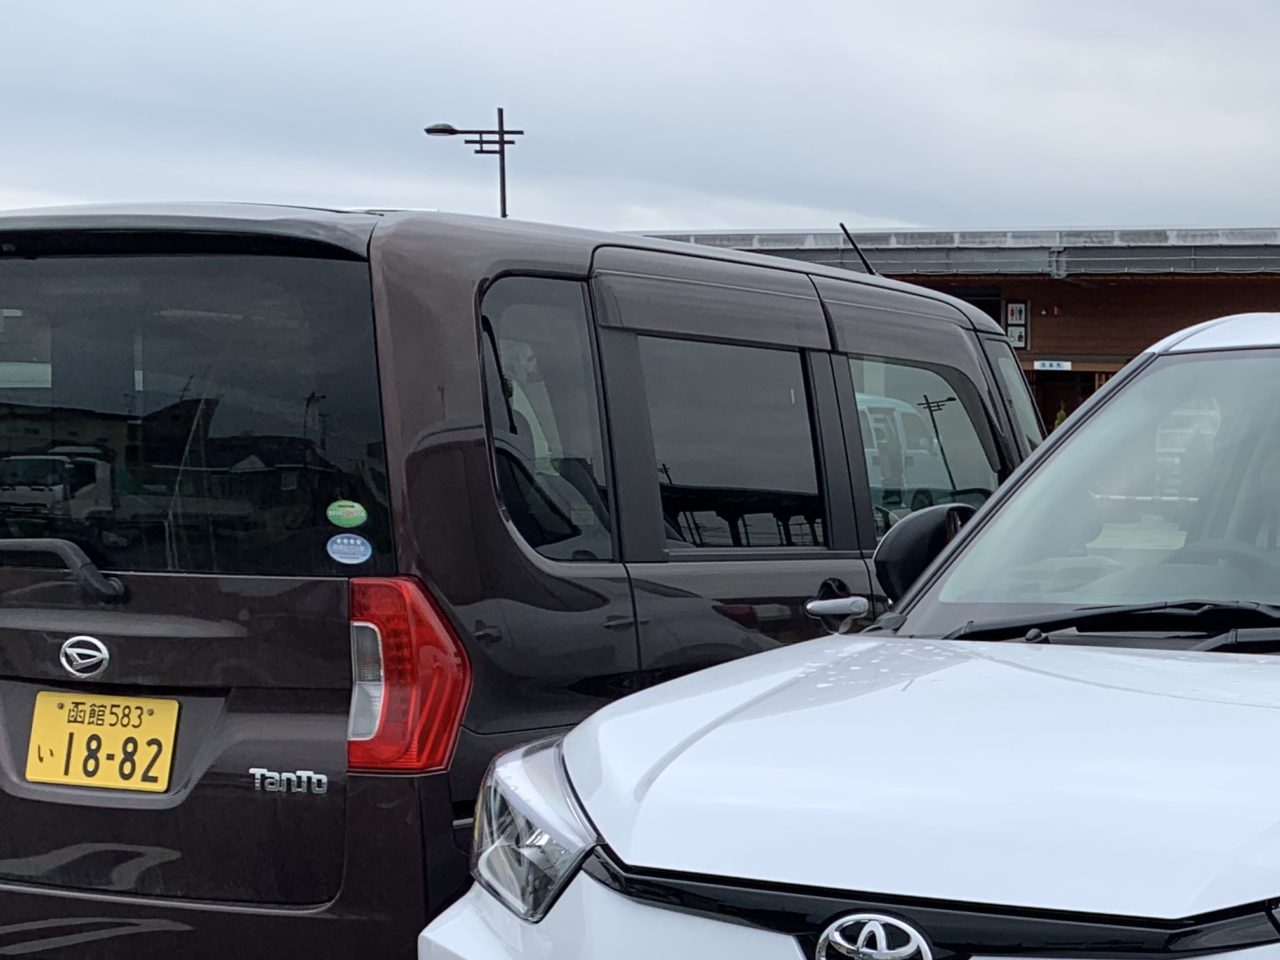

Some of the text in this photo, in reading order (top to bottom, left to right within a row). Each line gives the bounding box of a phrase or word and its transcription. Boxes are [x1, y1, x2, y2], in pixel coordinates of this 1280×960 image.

[67, 701, 145, 729] 函館583
[37, 731, 164, 784] い 18-82
